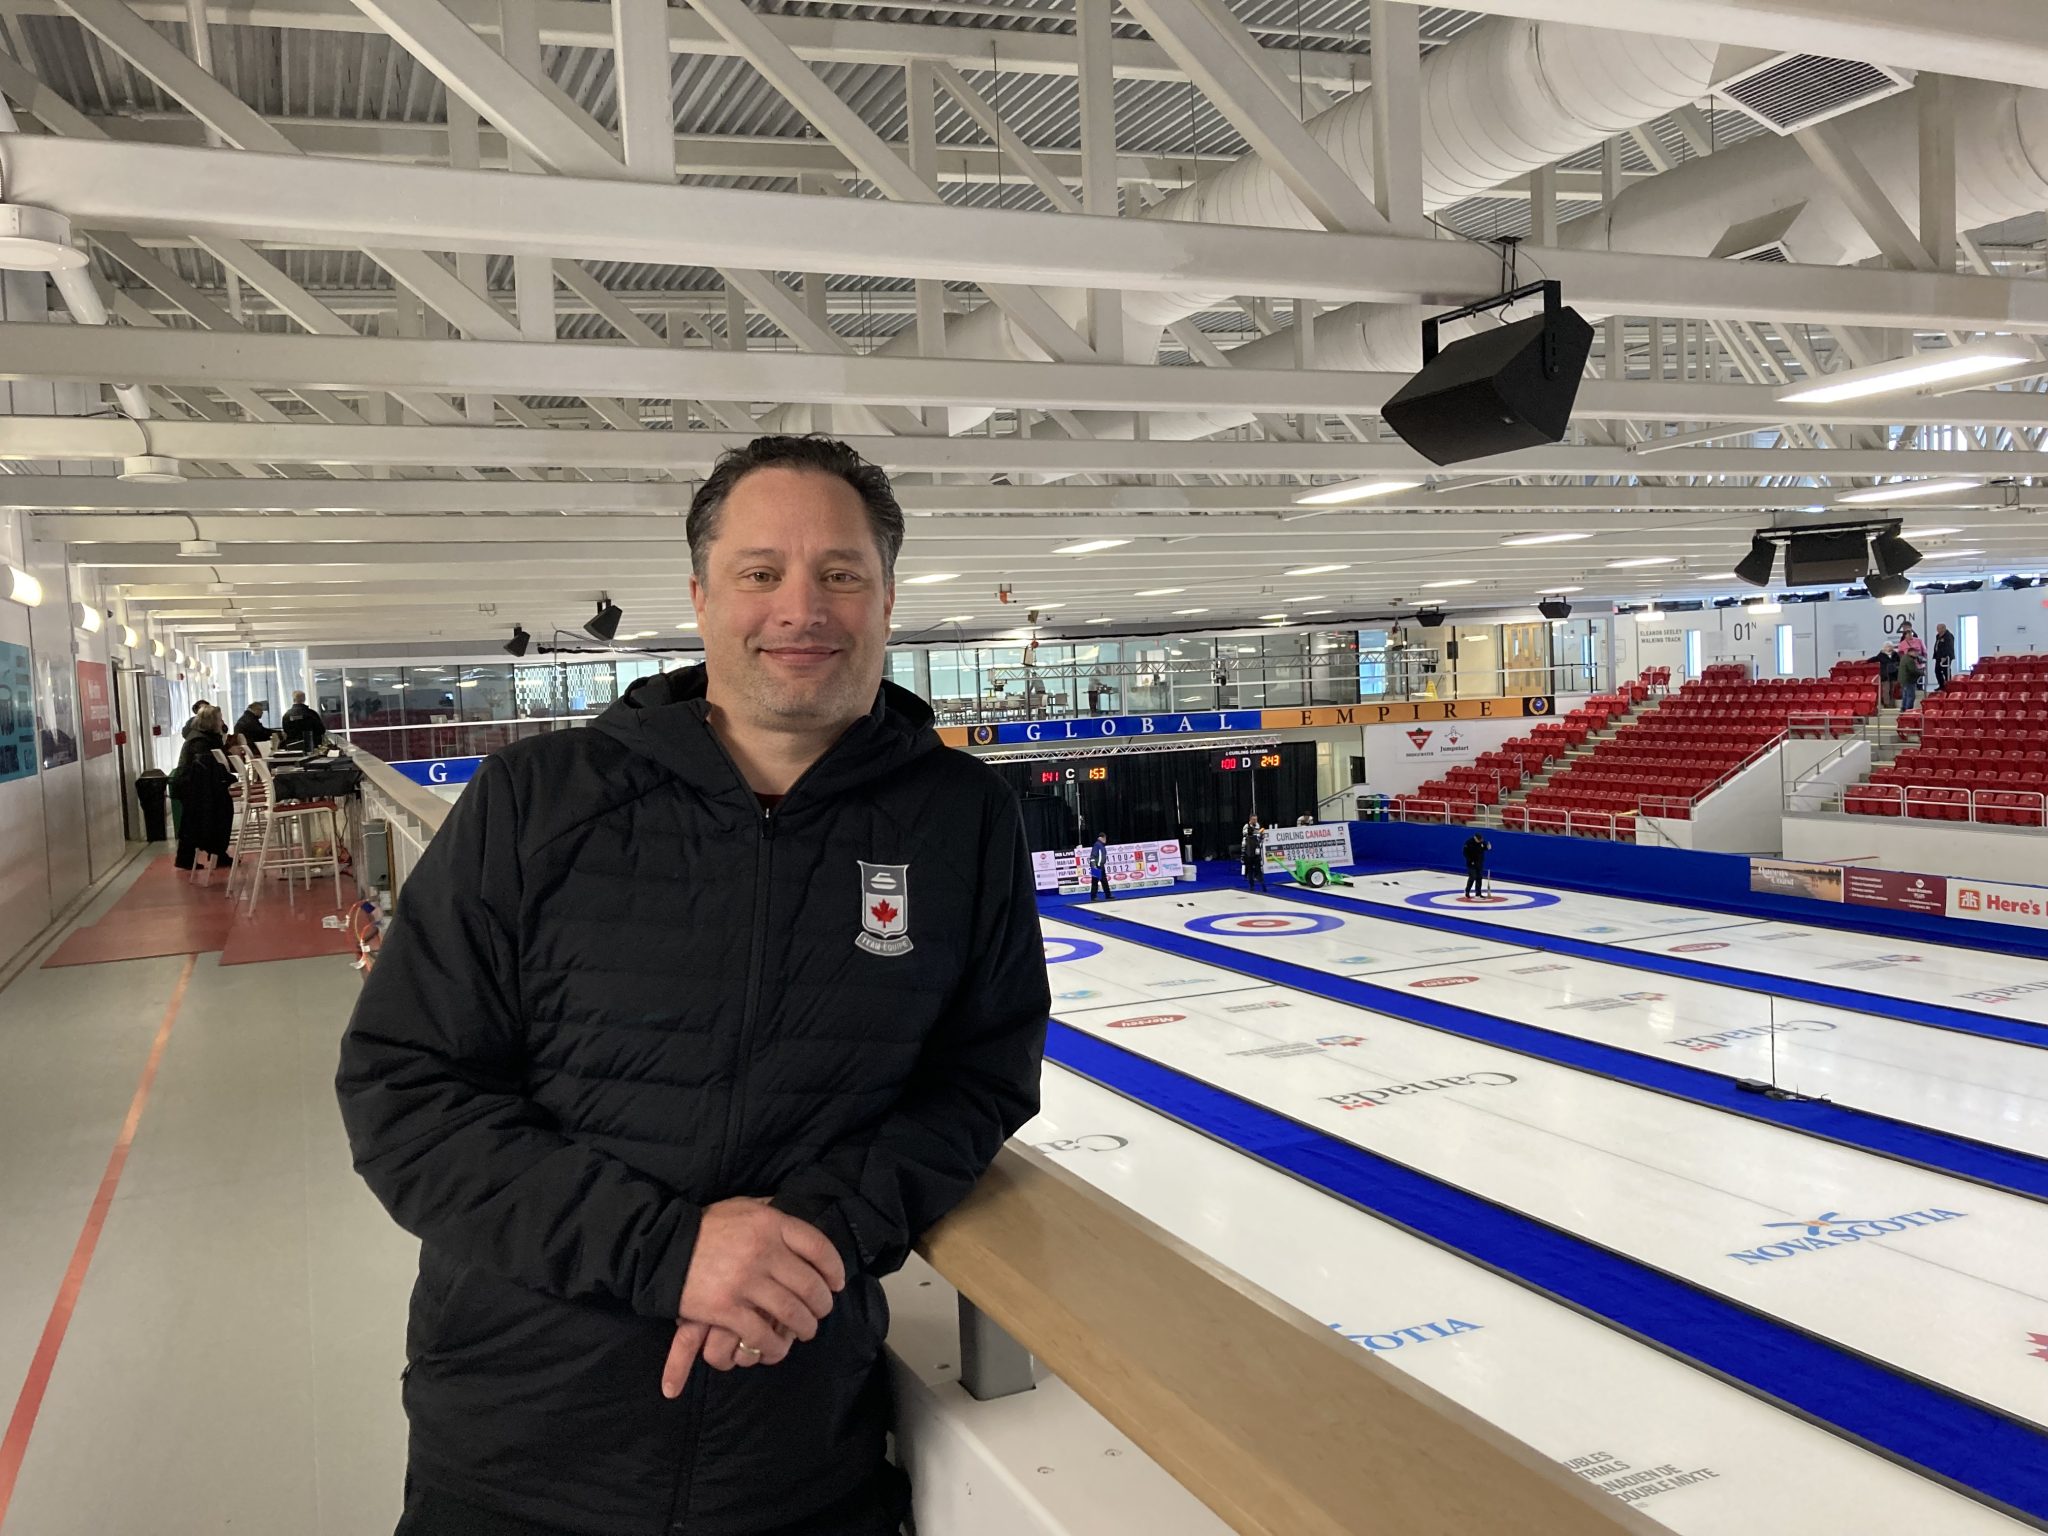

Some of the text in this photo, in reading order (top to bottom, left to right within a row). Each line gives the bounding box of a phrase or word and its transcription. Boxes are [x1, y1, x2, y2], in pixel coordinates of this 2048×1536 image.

[1026, 701, 1492, 741] GLOBAL EMPIRE
[1242, 757, 1251, 768] D
[1065, 768, 1075, 779] C
[1277, 829, 1331, 841] CURLING CANADA
[1986, 895, 2041, 915] Here's
[862, 937, 881, 950] TEAM
[1664, 1020, 1837, 1048] Canada
[1318, 1072, 1518, 1106] Canada
[1031, 1134, 1129, 1153] Ca
[1725, 1208, 1969, 1265] NOVA SCOTIA
[1577, 1460, 1631, 1480] TRIALS
[1657, 1464, 1682, 1475] DE
[1670, 1467, 1720, 1487] MIXTE
